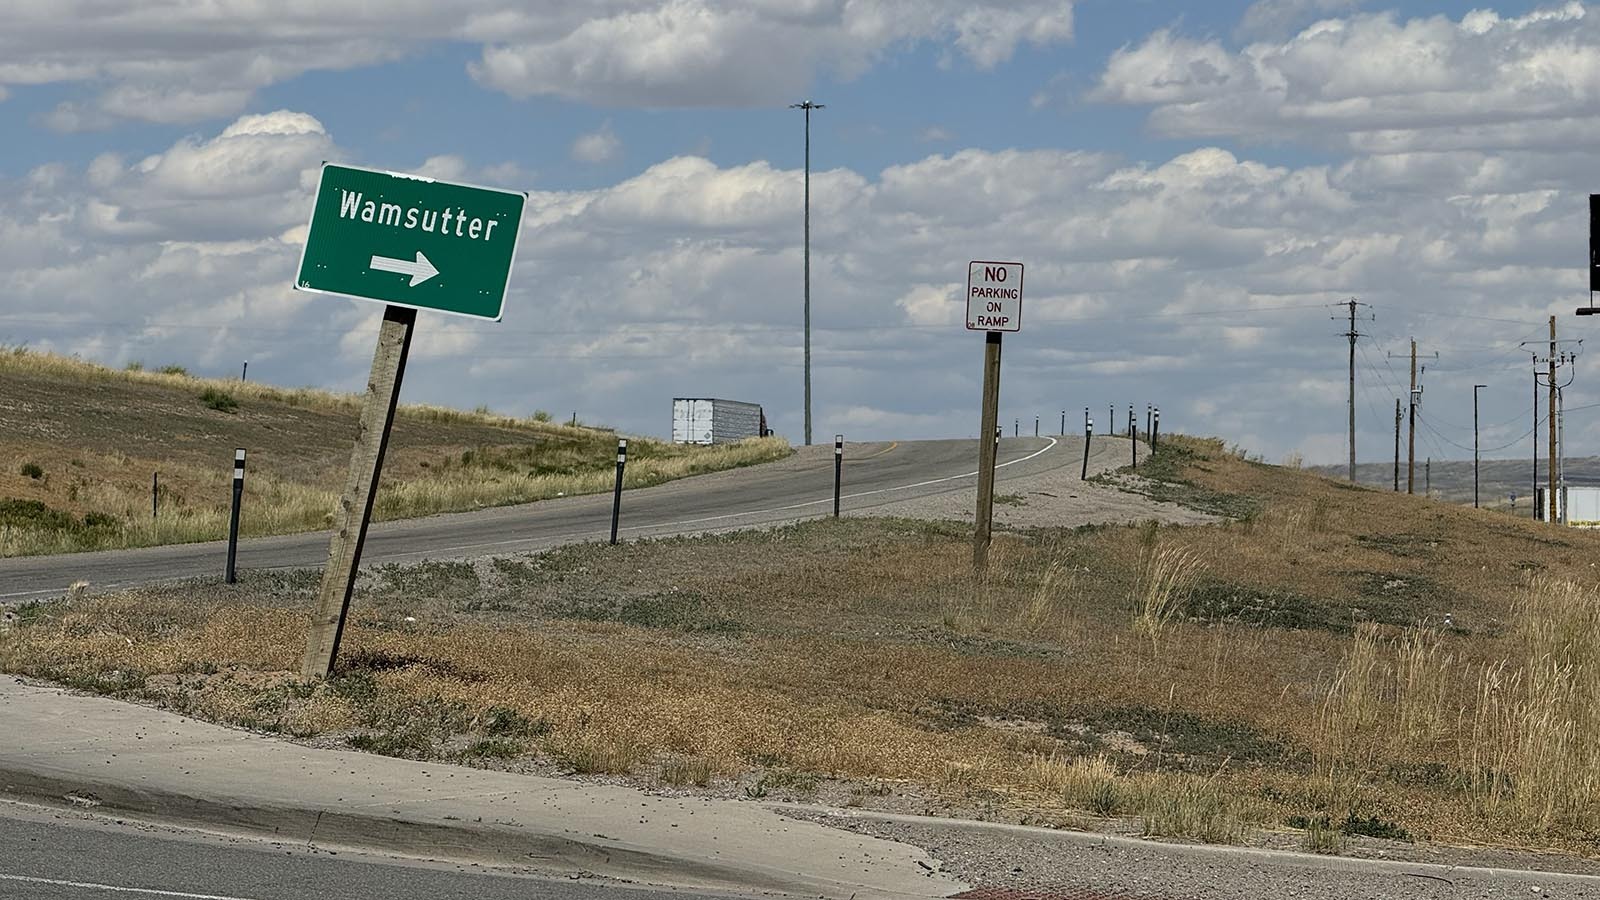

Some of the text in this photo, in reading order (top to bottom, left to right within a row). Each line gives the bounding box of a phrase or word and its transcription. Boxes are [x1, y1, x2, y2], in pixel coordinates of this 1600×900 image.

[339, 189, 498, 241] Wamsutter
[984, 266, 1007, 282] NO
[301, 280, 310, 289] 16
[971, 287, 1018, 299] PARKING
[986, 302, 1002, 312] ON
[977, 315, 1009, 327] RAMP
